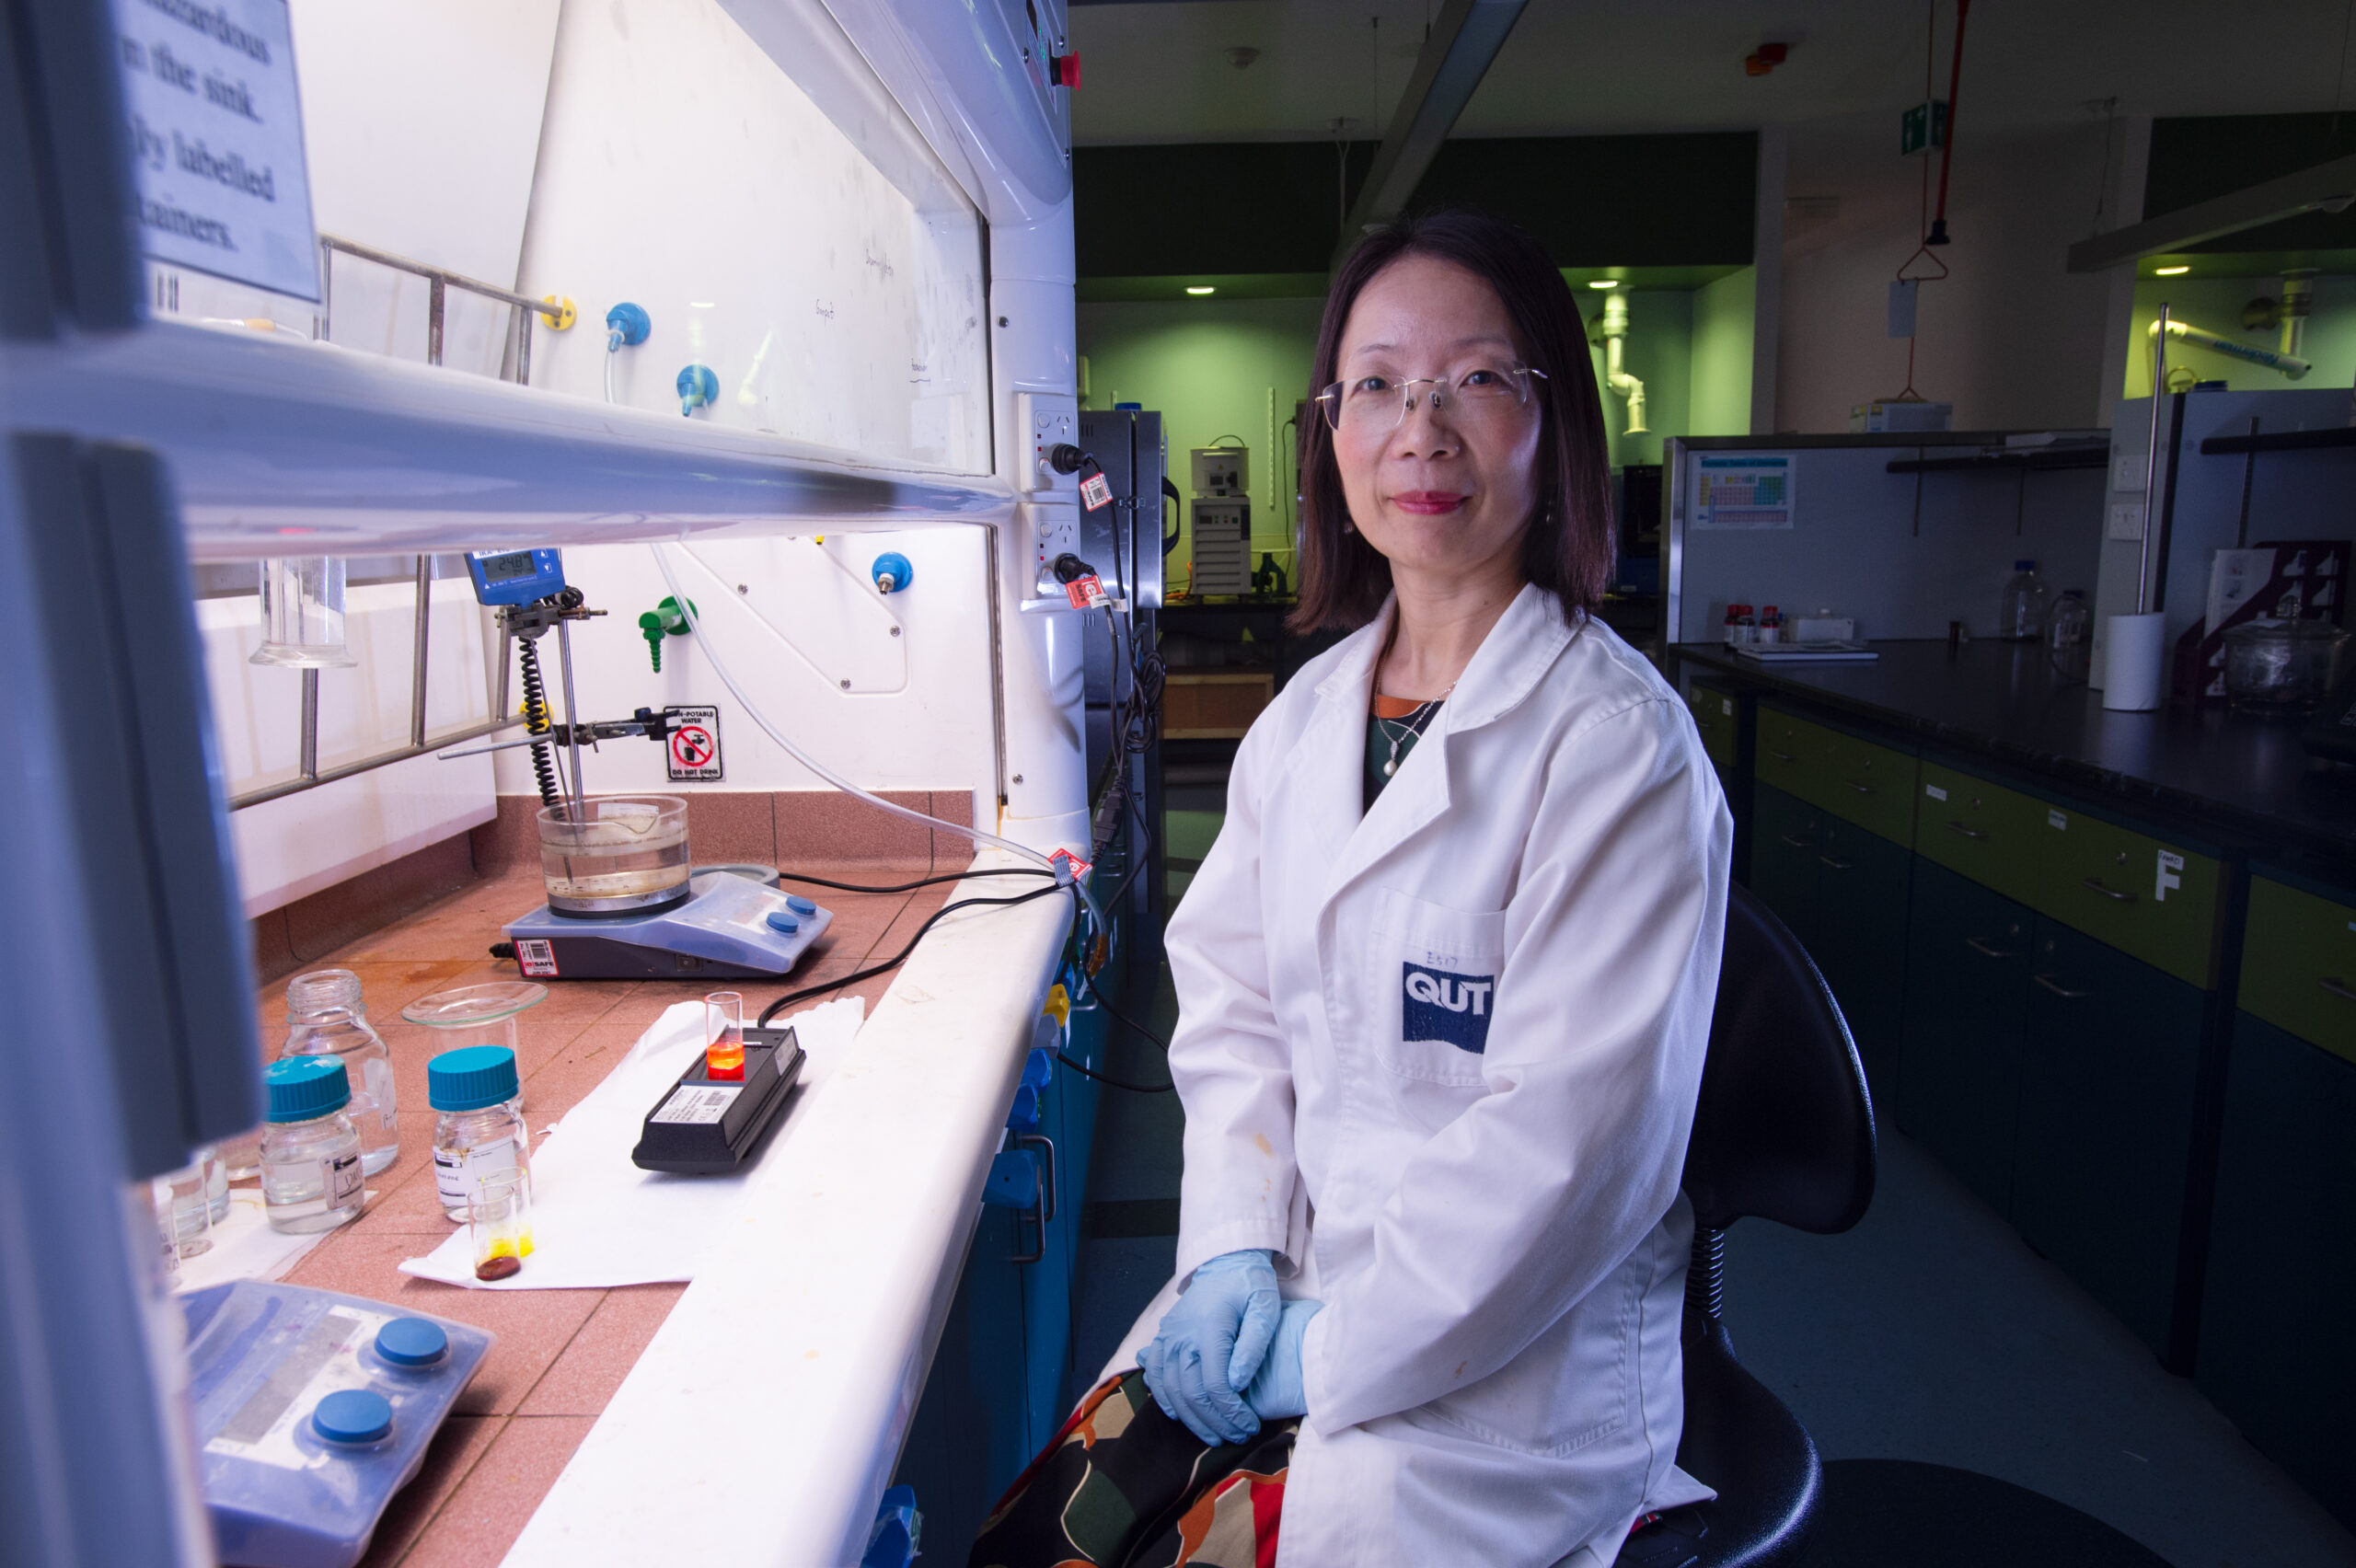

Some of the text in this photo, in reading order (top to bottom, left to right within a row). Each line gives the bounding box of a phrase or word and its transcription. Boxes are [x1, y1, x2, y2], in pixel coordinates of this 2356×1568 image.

[144, 0, 271, 65] azardous
[150, 41, 198, 96] the
[202, 68, 264, 124] sink.
[172, 129, 276, 202] labelled
[137, 190, 239, 253] tainers.
[1405, 972, 1492, 1016] QUT
